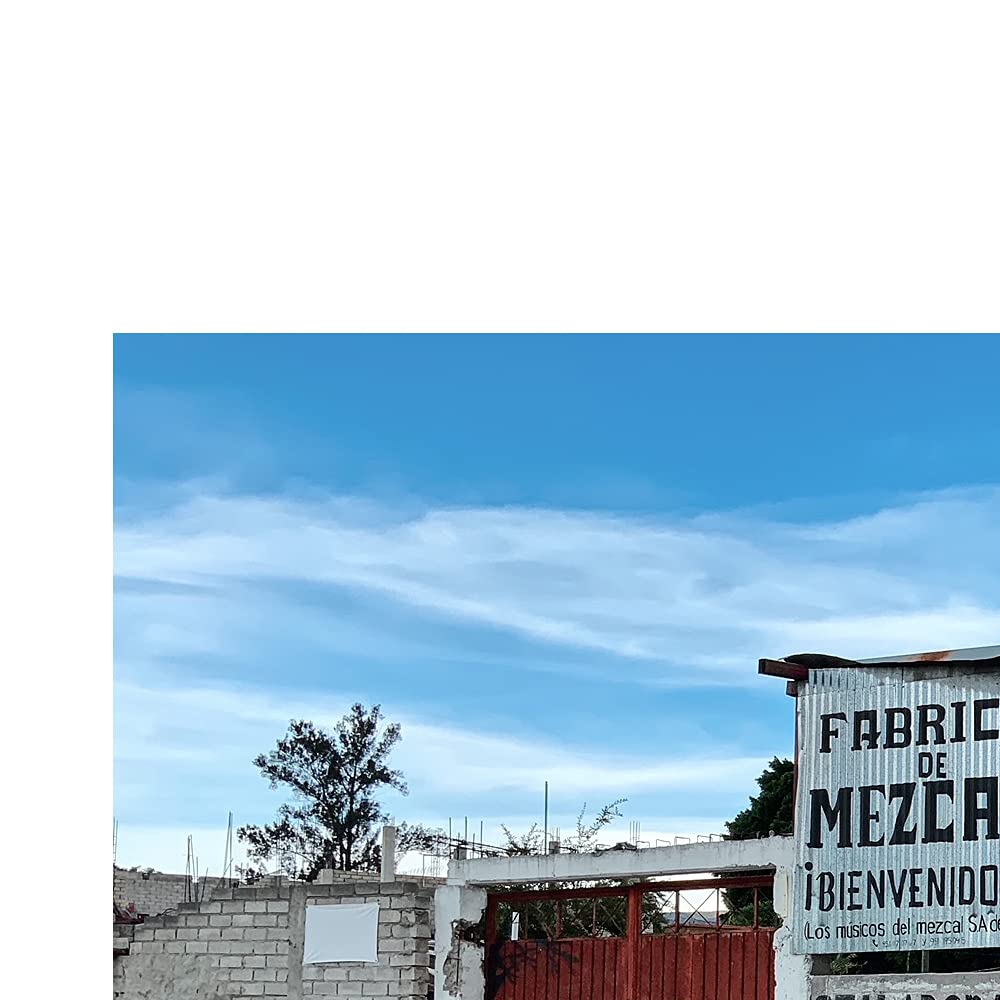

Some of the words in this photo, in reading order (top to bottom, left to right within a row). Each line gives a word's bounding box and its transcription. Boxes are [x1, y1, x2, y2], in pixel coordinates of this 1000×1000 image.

[918, 751, 947, 778] DE
[892, 917, 910, 936] del
[916, 915, 964, 935] mezcal
